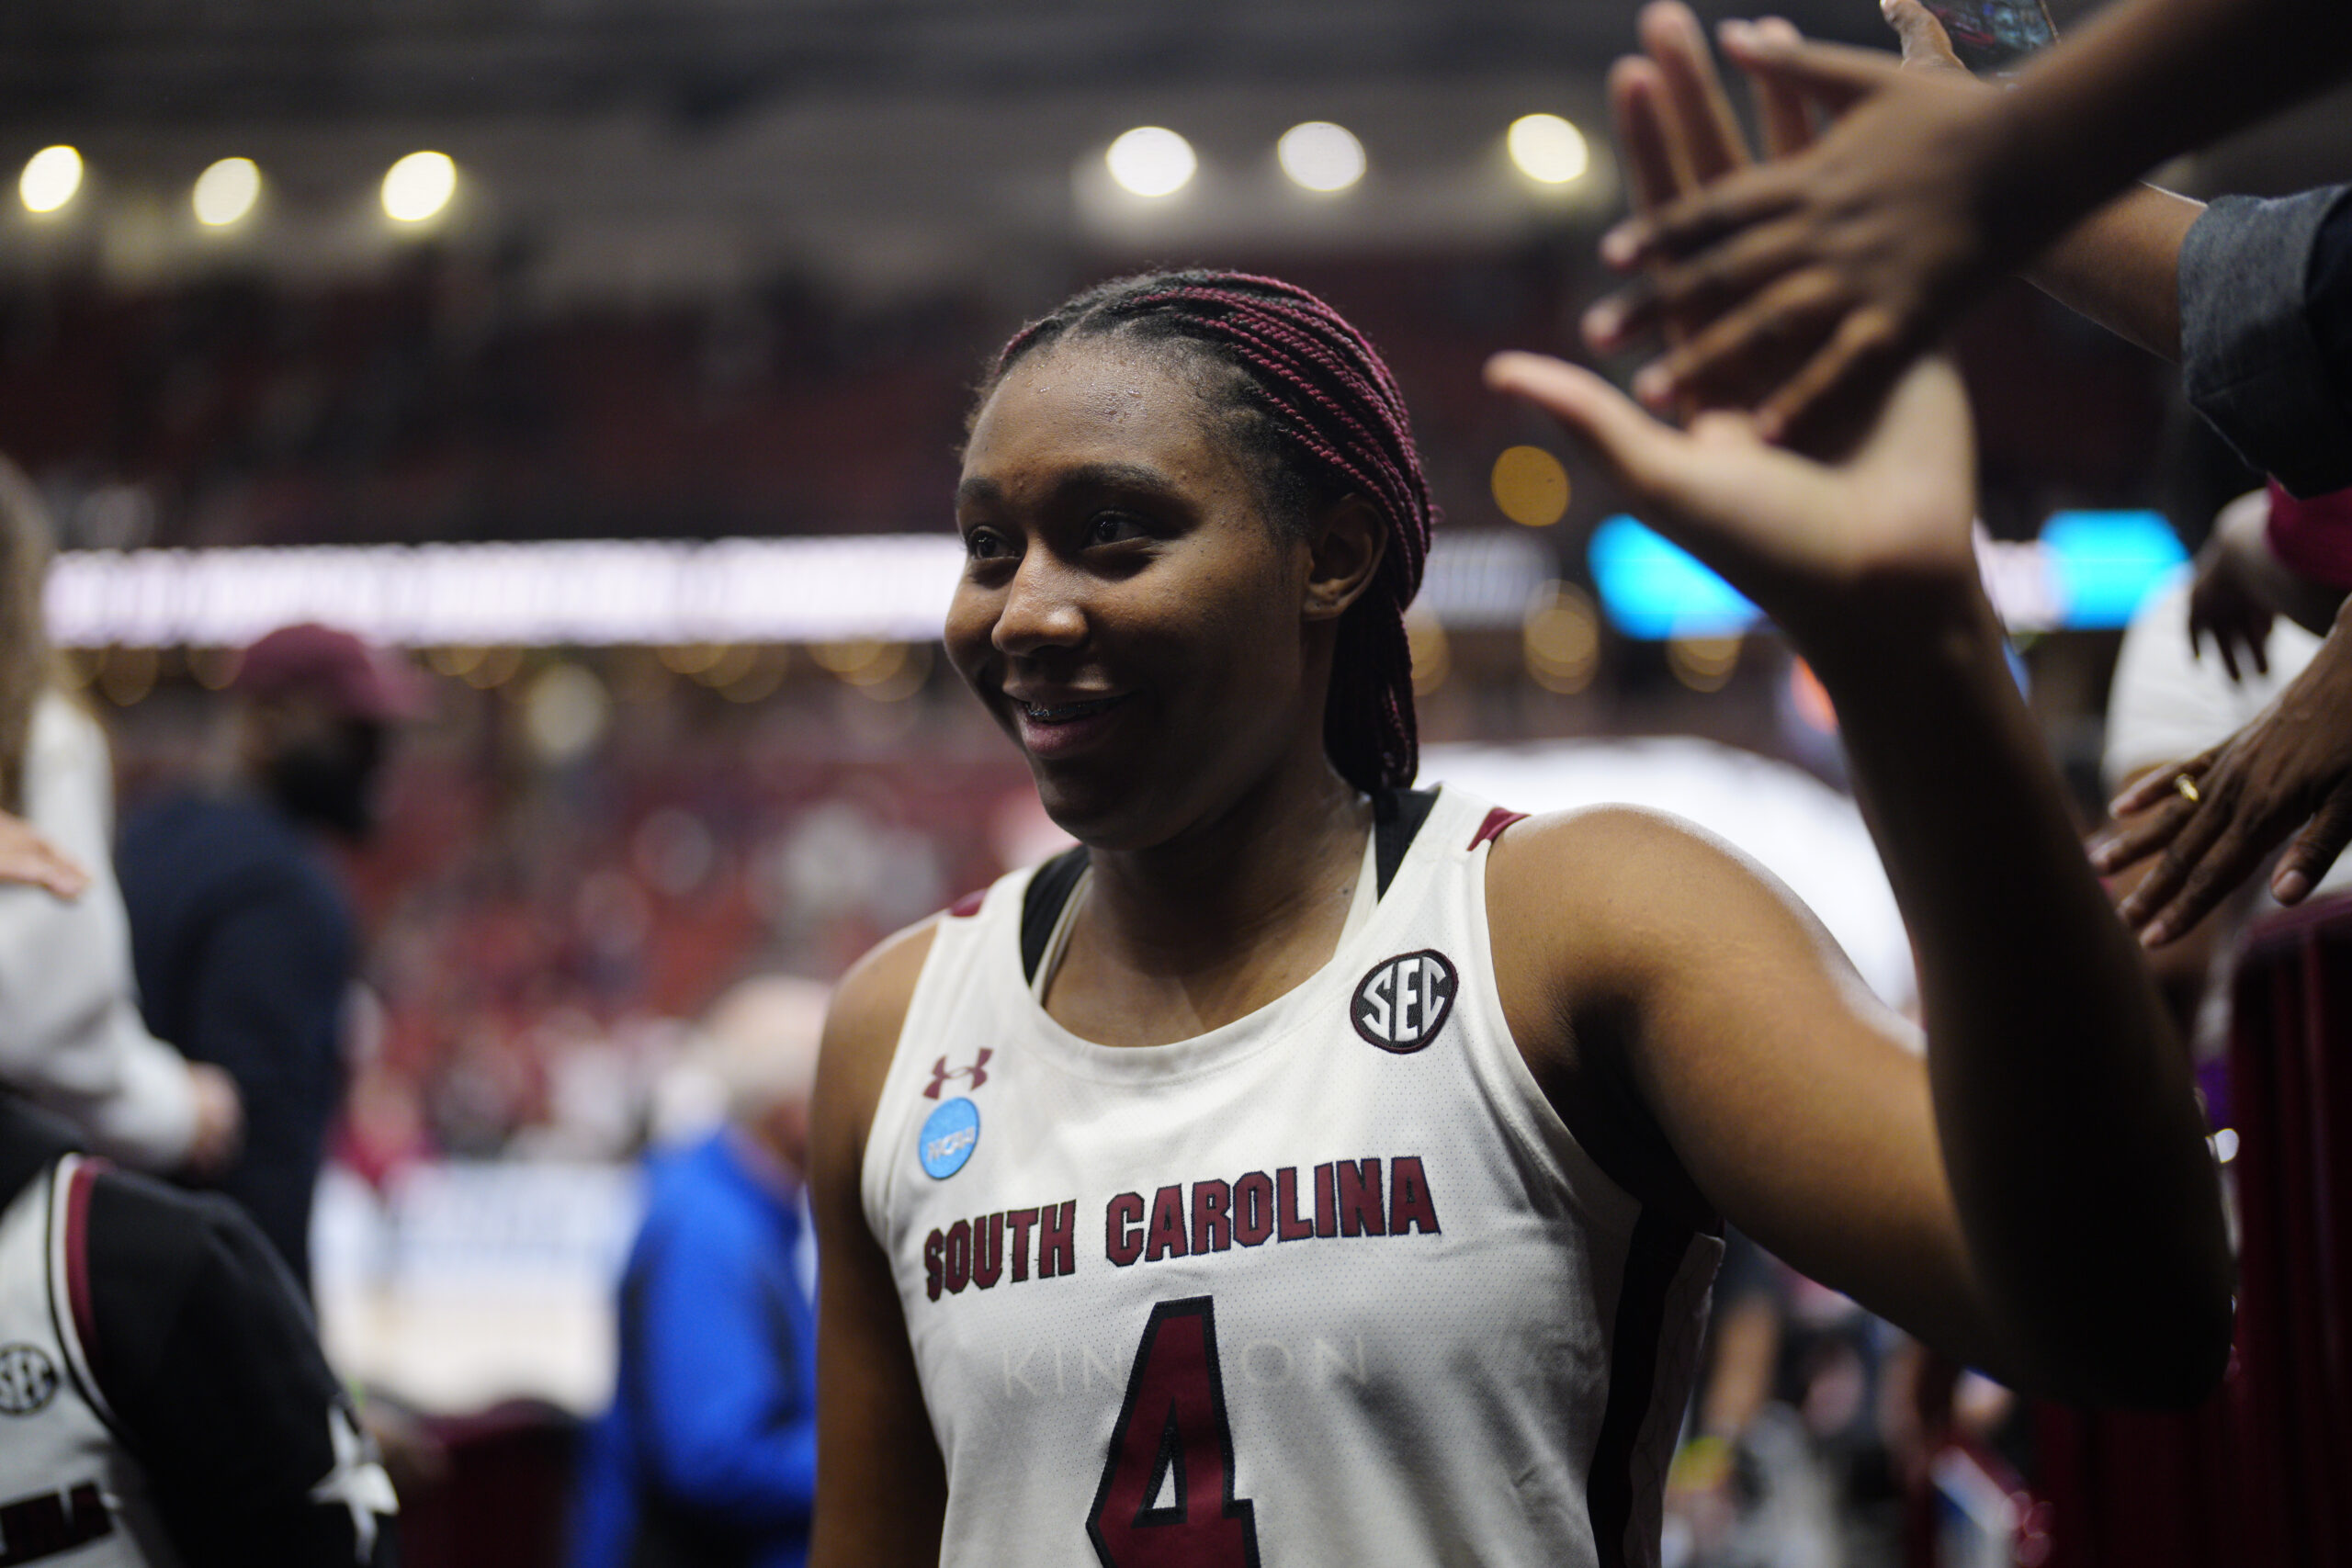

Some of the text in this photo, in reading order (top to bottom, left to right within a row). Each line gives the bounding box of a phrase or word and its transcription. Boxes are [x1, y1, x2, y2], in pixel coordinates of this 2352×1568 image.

[1362, 955, 1447, 1042] SEC
[924, 1156, 1442, 1303] SOUTH CAROLINA
[1085, 1294, 1261, 1568] 4
